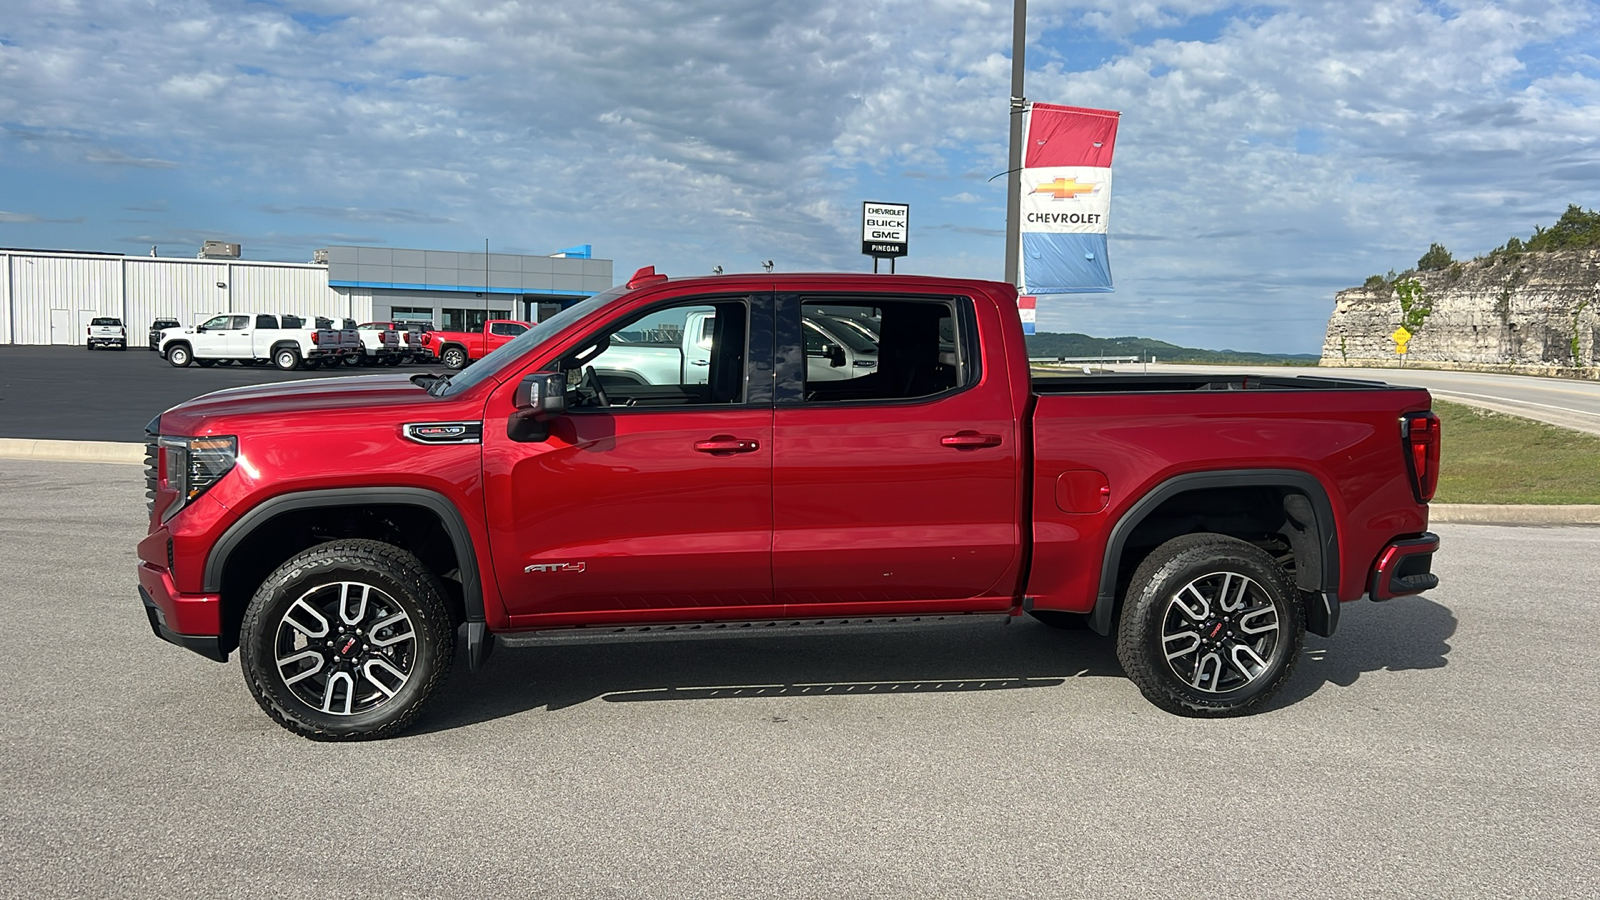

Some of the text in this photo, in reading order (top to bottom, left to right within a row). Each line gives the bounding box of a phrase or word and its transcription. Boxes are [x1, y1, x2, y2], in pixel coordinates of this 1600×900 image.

[868, 207, 905, 216] CHEVROLET
[1027, 212, 1101, 224] CHEVROLET
[866, 219, 905, 228] BUICK
[871, 230, 900, 239] GMC
[524, 561, 586, 573] AT4
